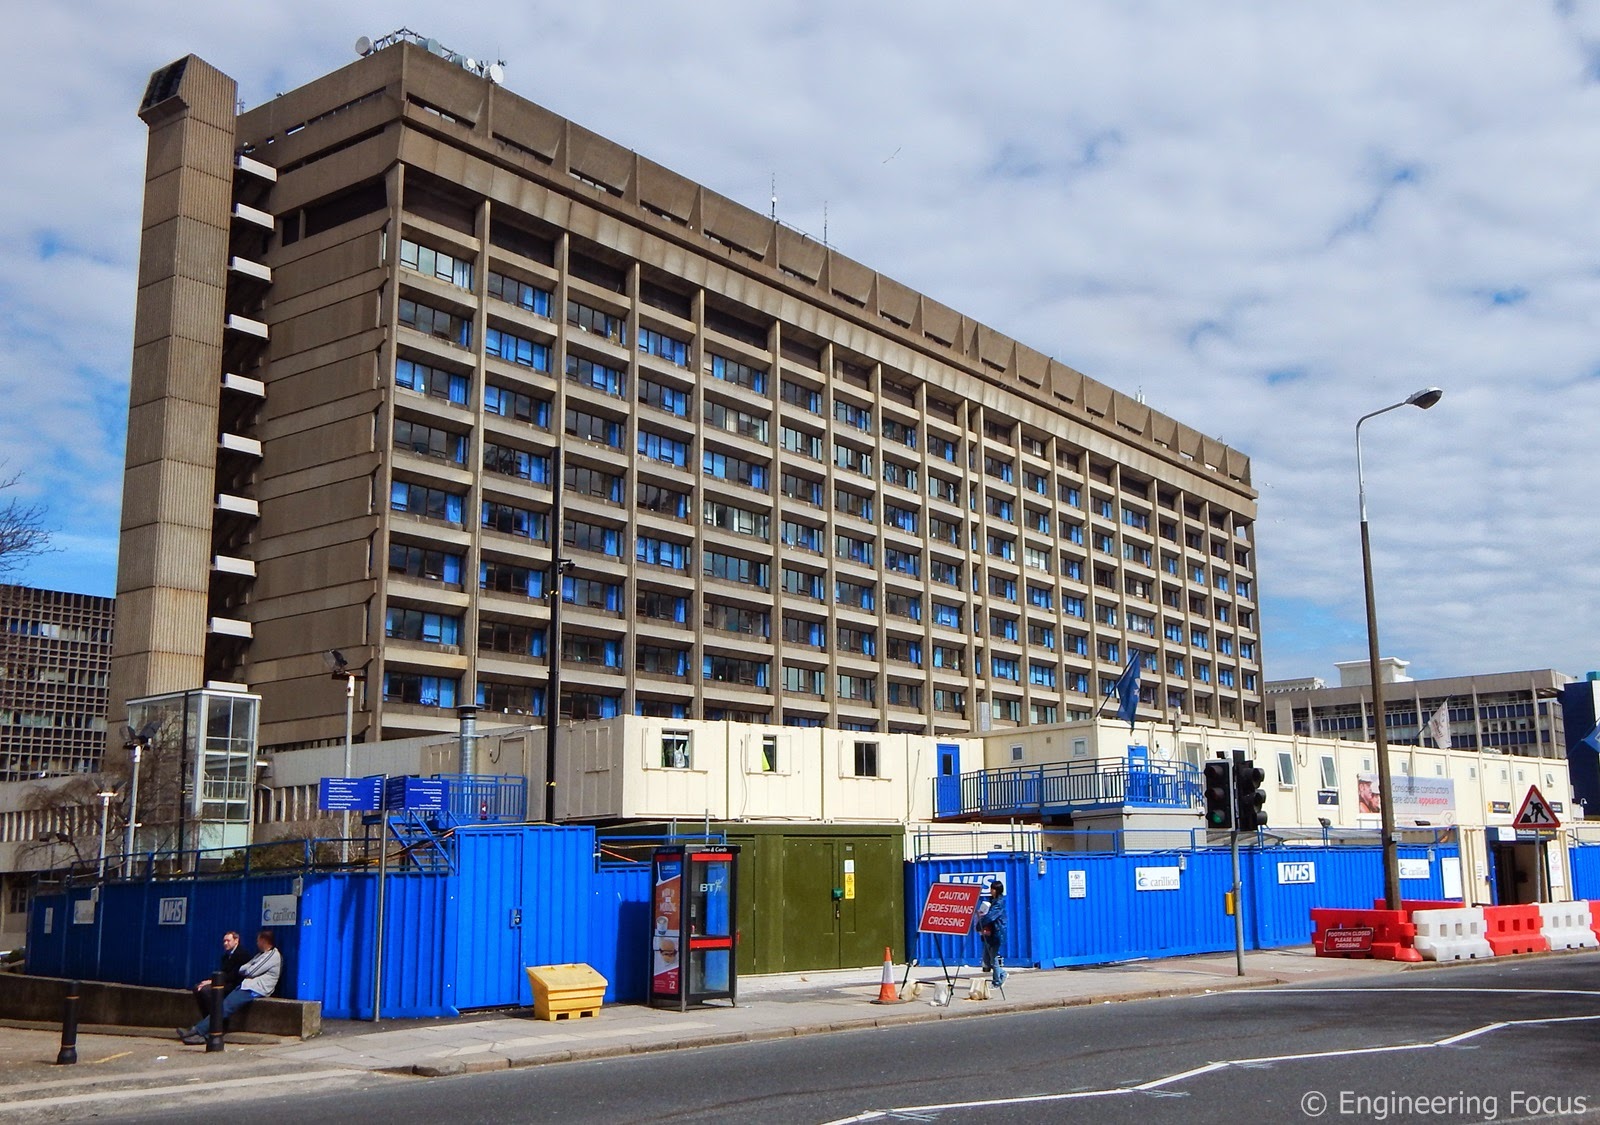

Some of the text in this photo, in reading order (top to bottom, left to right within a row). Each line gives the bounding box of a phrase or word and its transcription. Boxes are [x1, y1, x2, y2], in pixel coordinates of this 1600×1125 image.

[1419, 797, 1448, 806] appearance
[1285, 864, 1309, 881] NHS
[700, 883, 715, 892] BT
[938, 891, 970, 901] CAUTION
[163, 901, 182, 921] NHS
[927, 903, 974, 915] PEDESTRIANS
[928, 916, 965, 927] CROSSING
